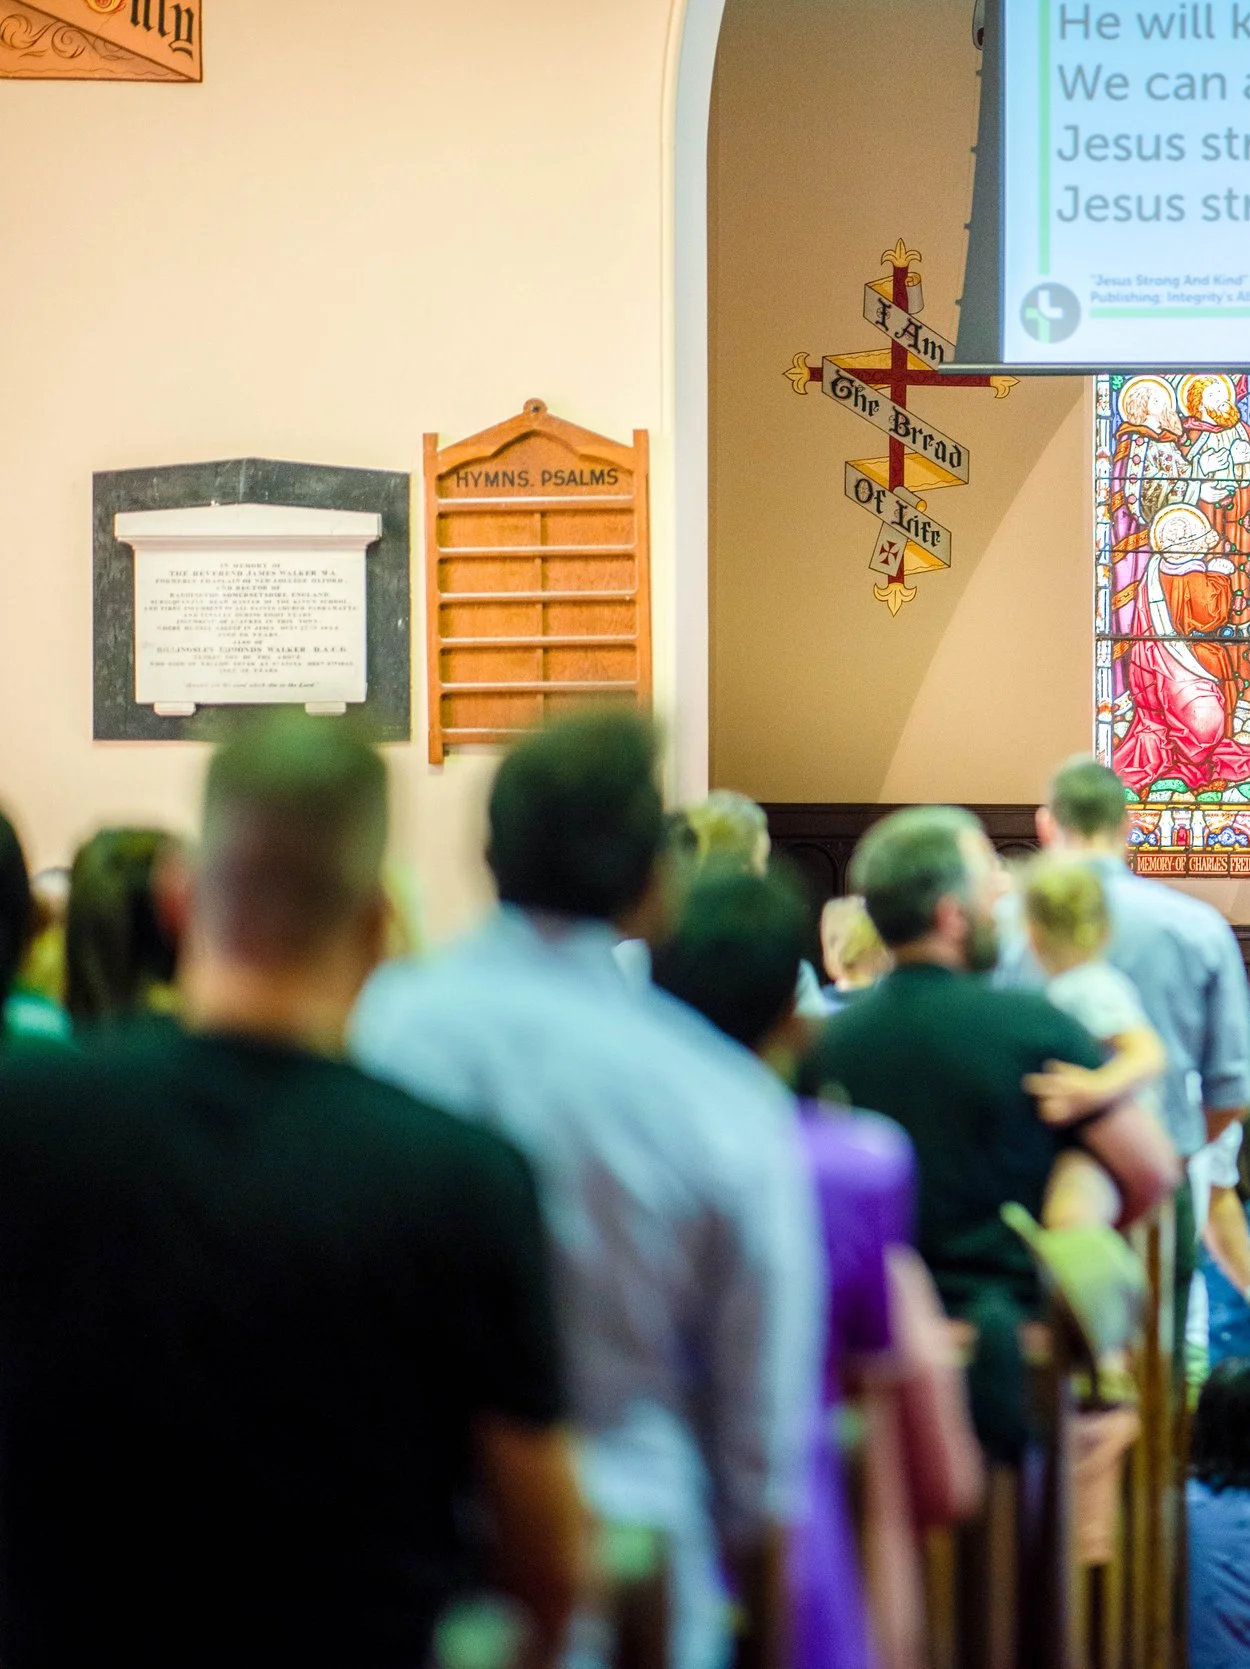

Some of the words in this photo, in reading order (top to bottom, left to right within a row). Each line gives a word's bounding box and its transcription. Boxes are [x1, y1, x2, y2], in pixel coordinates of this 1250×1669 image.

[1058, 2, 1122, 40] He
[1136, 2, 1216, 40] will
[1057, 63, 1130, 101] We
[1144, 71, 1228, 101] can
[1056, 124, 1187, 162] Jesus
[1056, 185, 1187, 222] Jesus
[1136, 274, 1180, 289] Strong
[1183, 274, 1210, 286] And
[874, 297, 892, 332] I
[895, 317, 945, 363] Am
[829, 369, 880, 418] The
[888, 405, 962, 470] Bread
[541, 467, 619, 487] PSALMS
[853, 477, 887, 516] Of
[891, 501, 941, 548] Life
[1137, 856, 1173, 871] MEMORY
[1175, 856, 1187, 871] OF
[1188, 856, 1228, 871] CHARLES
